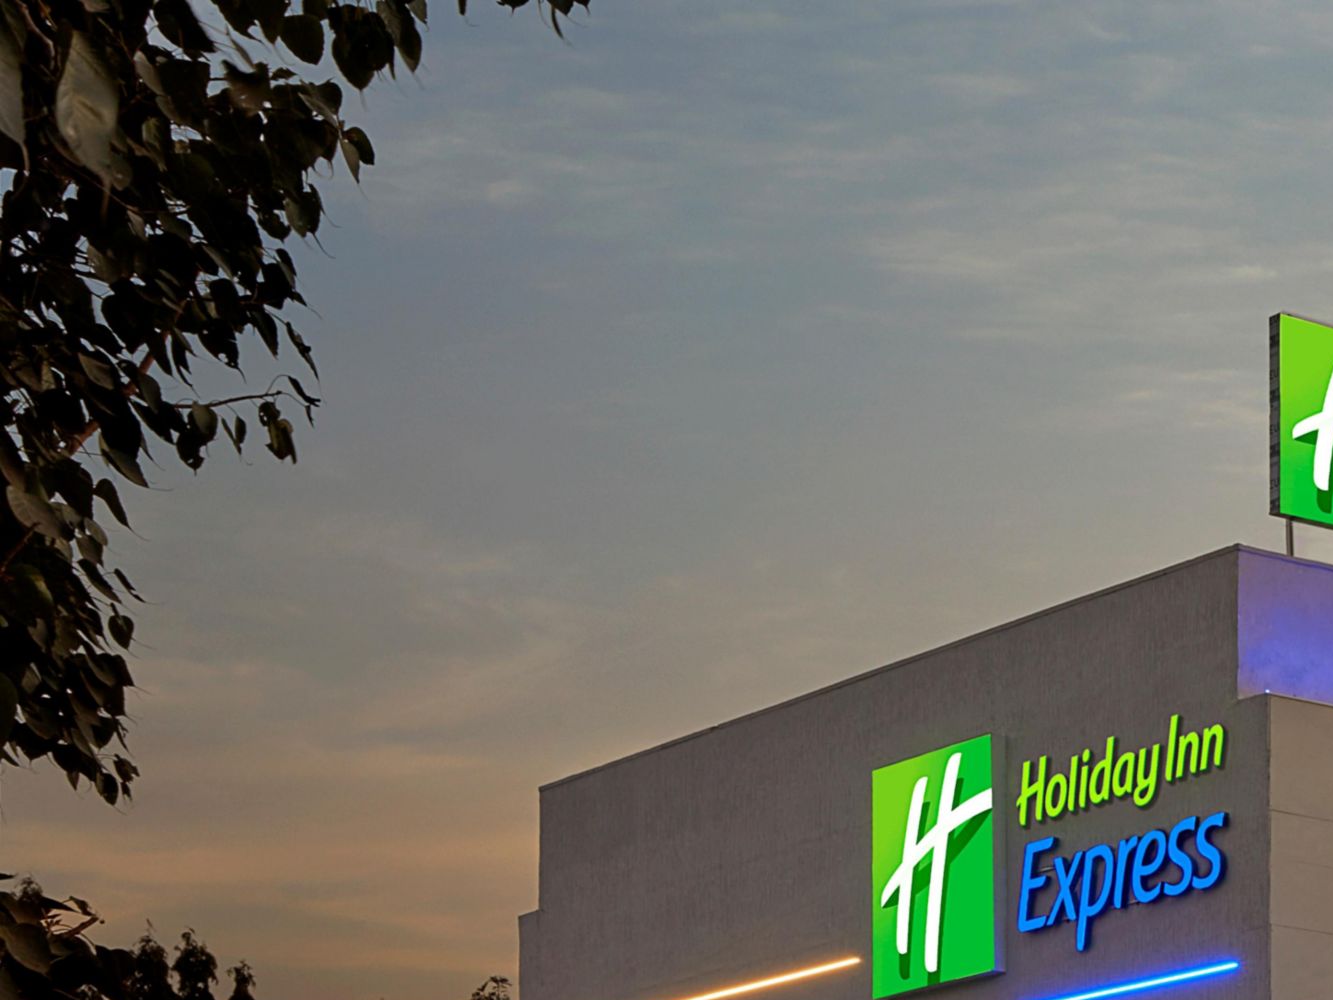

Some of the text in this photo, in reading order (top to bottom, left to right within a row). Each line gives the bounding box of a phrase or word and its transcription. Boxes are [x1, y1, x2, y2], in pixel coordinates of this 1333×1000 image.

[1015, 713, 1225, 827] Holiday Inn
[1016, 810, 1227, 953] Express
